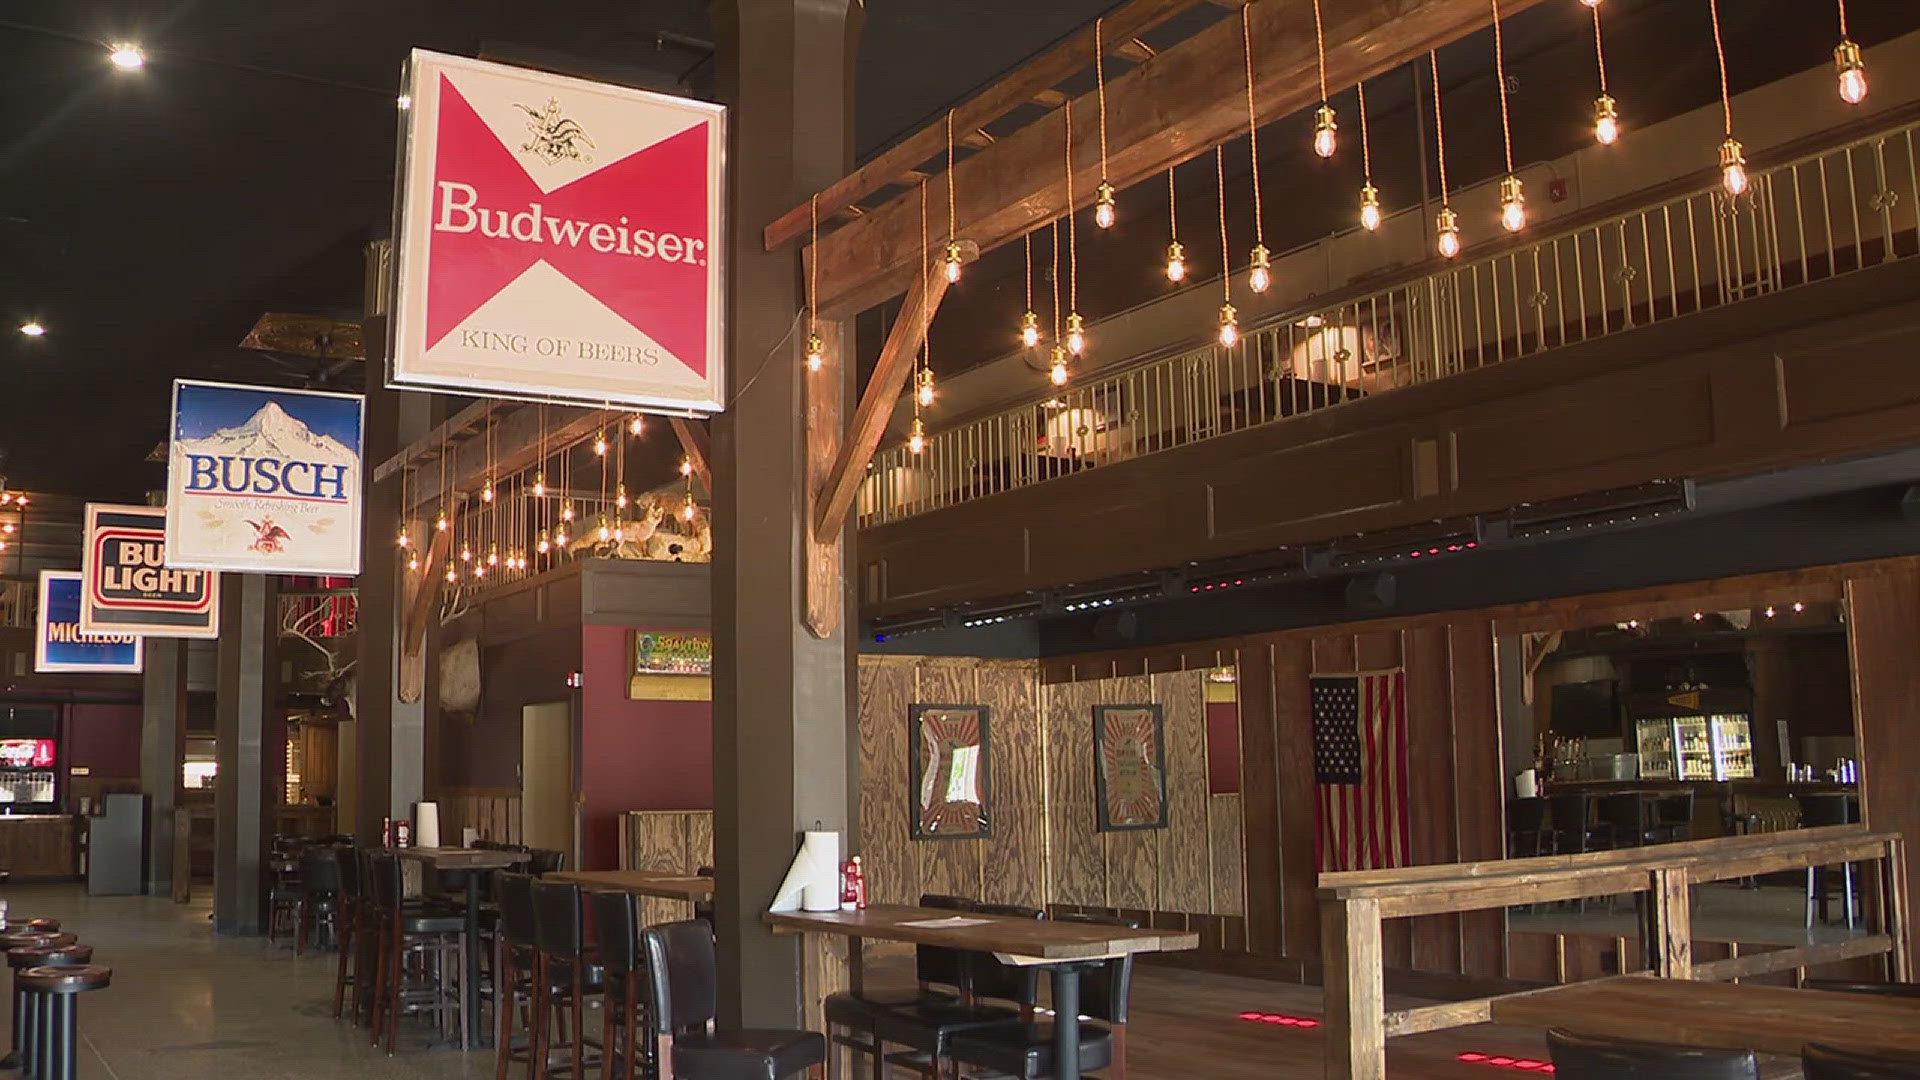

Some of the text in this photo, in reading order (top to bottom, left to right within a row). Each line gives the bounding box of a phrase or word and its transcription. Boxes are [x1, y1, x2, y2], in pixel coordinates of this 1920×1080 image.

[461, 329, 659, 366] KING OF BEERS
[184, 453, 348, 499] BUSCH
[119, 541, 164, 567] BU
[104, 565, 201, 593] LIGHT
